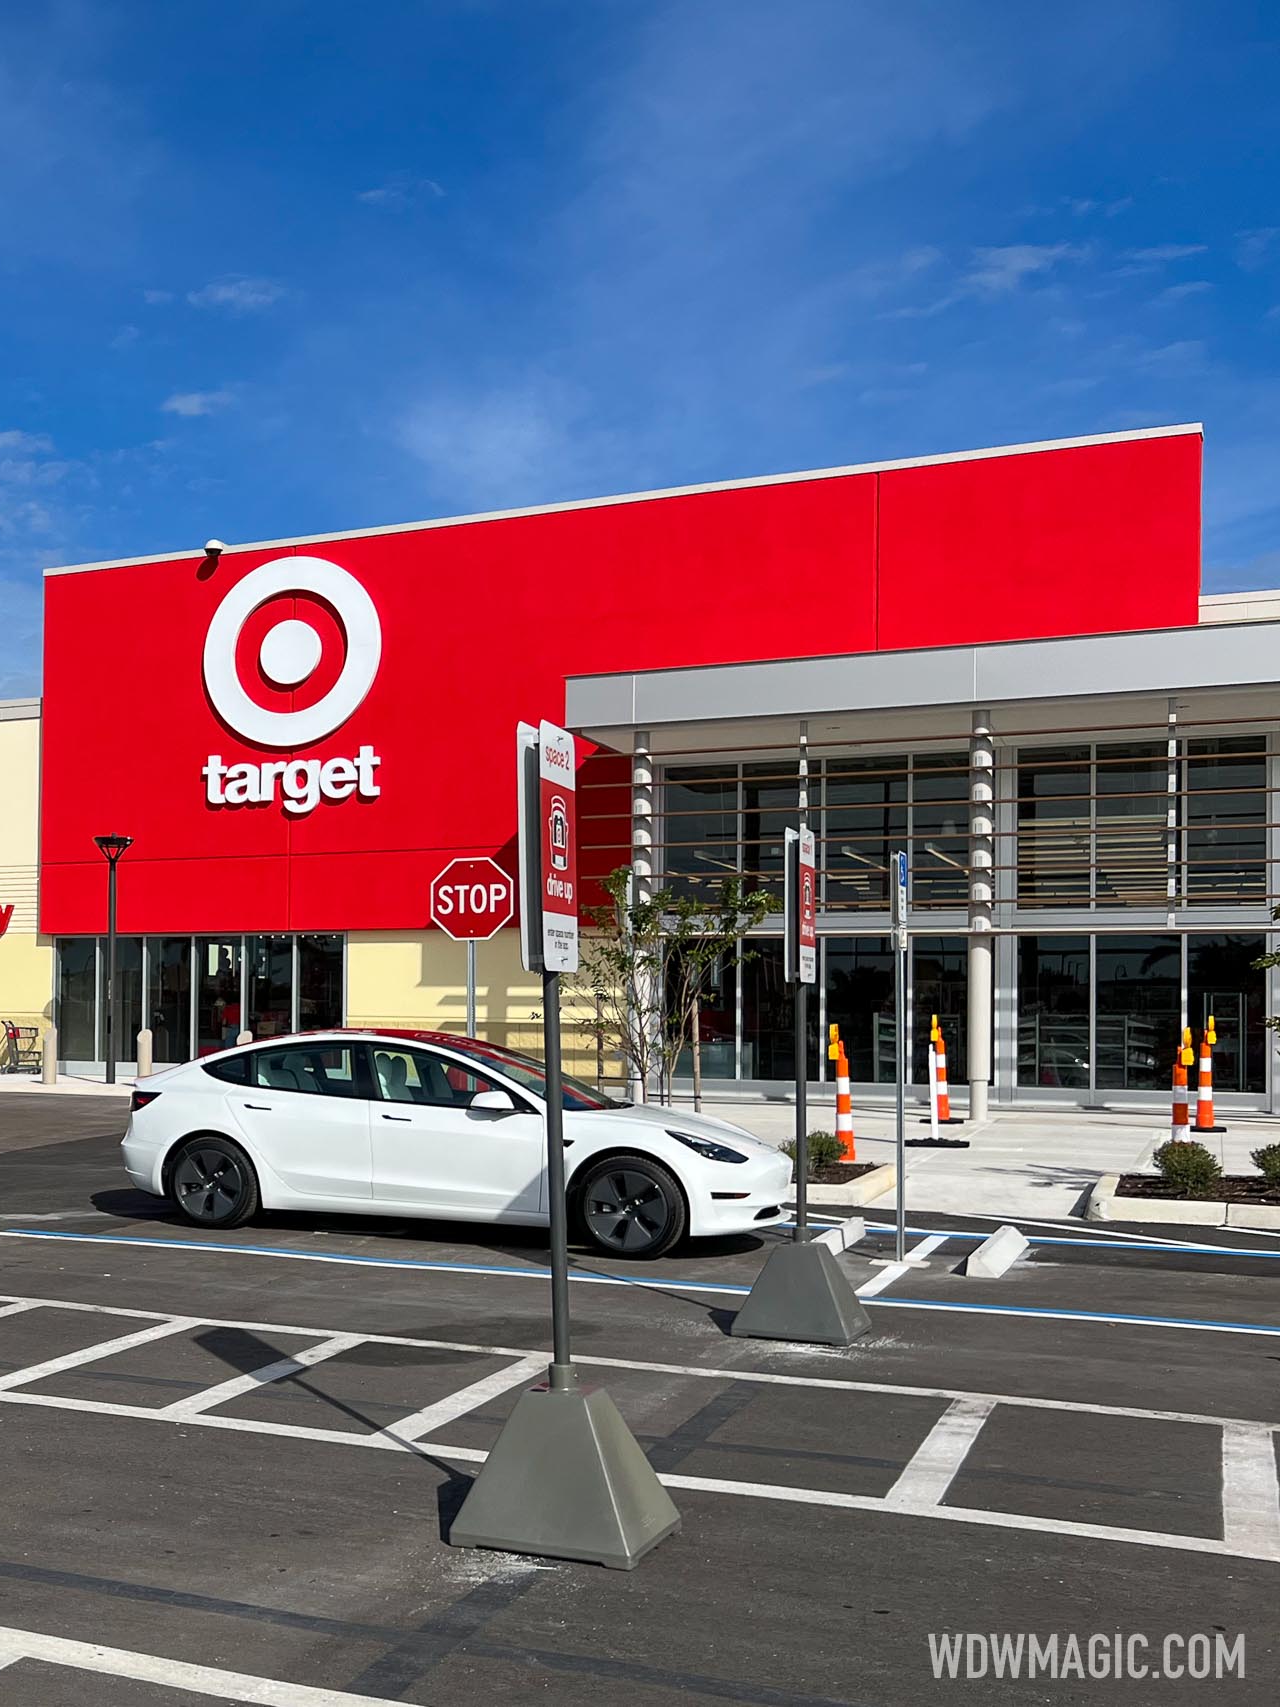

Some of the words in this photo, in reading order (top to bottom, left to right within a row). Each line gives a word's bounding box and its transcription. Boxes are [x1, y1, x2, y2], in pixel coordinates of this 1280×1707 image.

[202, 745, 381, 813] target
[437, 884, 507, 915] STOP
[546, 872, 564, 898] drive
[564, 882, 573, 905] up
